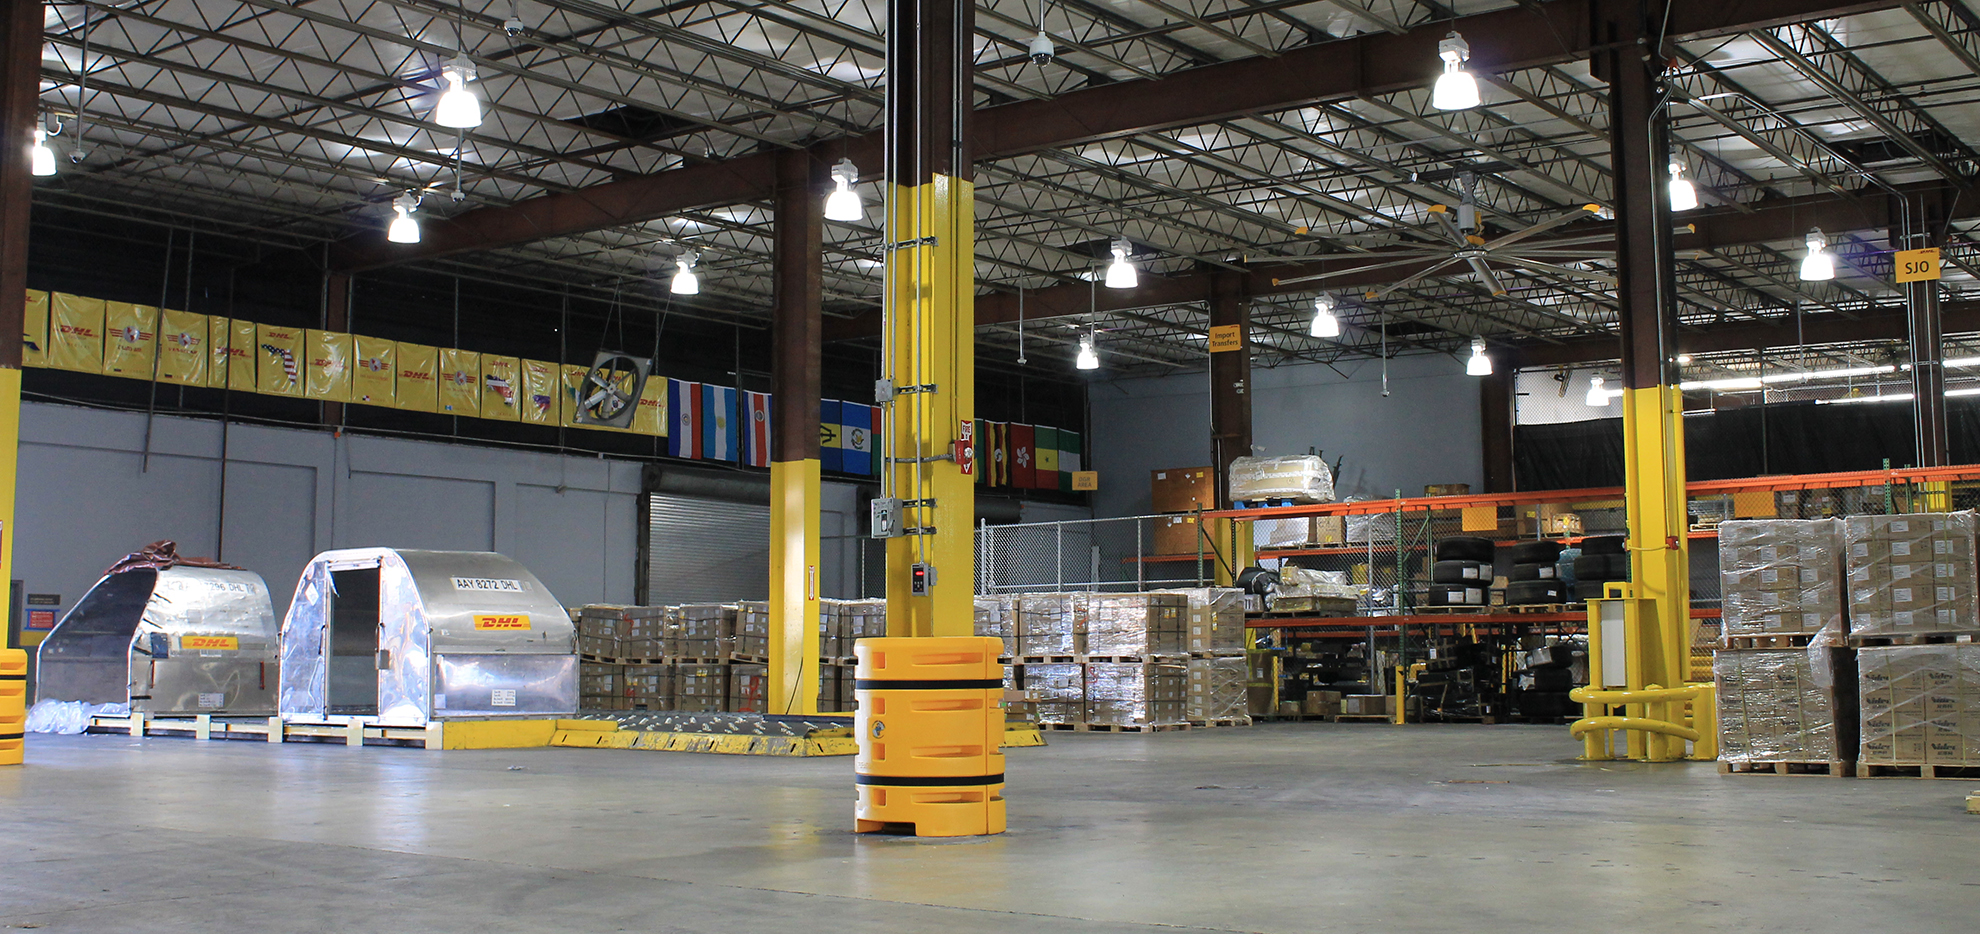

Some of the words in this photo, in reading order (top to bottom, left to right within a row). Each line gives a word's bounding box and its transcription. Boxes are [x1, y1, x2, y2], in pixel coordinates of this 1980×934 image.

[1905, 261, 1929, 274] SJO
[61, 325, 93, 337] DHL
[404, 371, 429, 380] DHL
[229, 583, 244, 591] DHL
[457, 579, 474, 589] AAY
[475, 579, 499, 589] 8272
[501, 580, 518, 590] DHL
[482, 618, 522, 627] DHL
[193, 638, 229, 647] DHL
